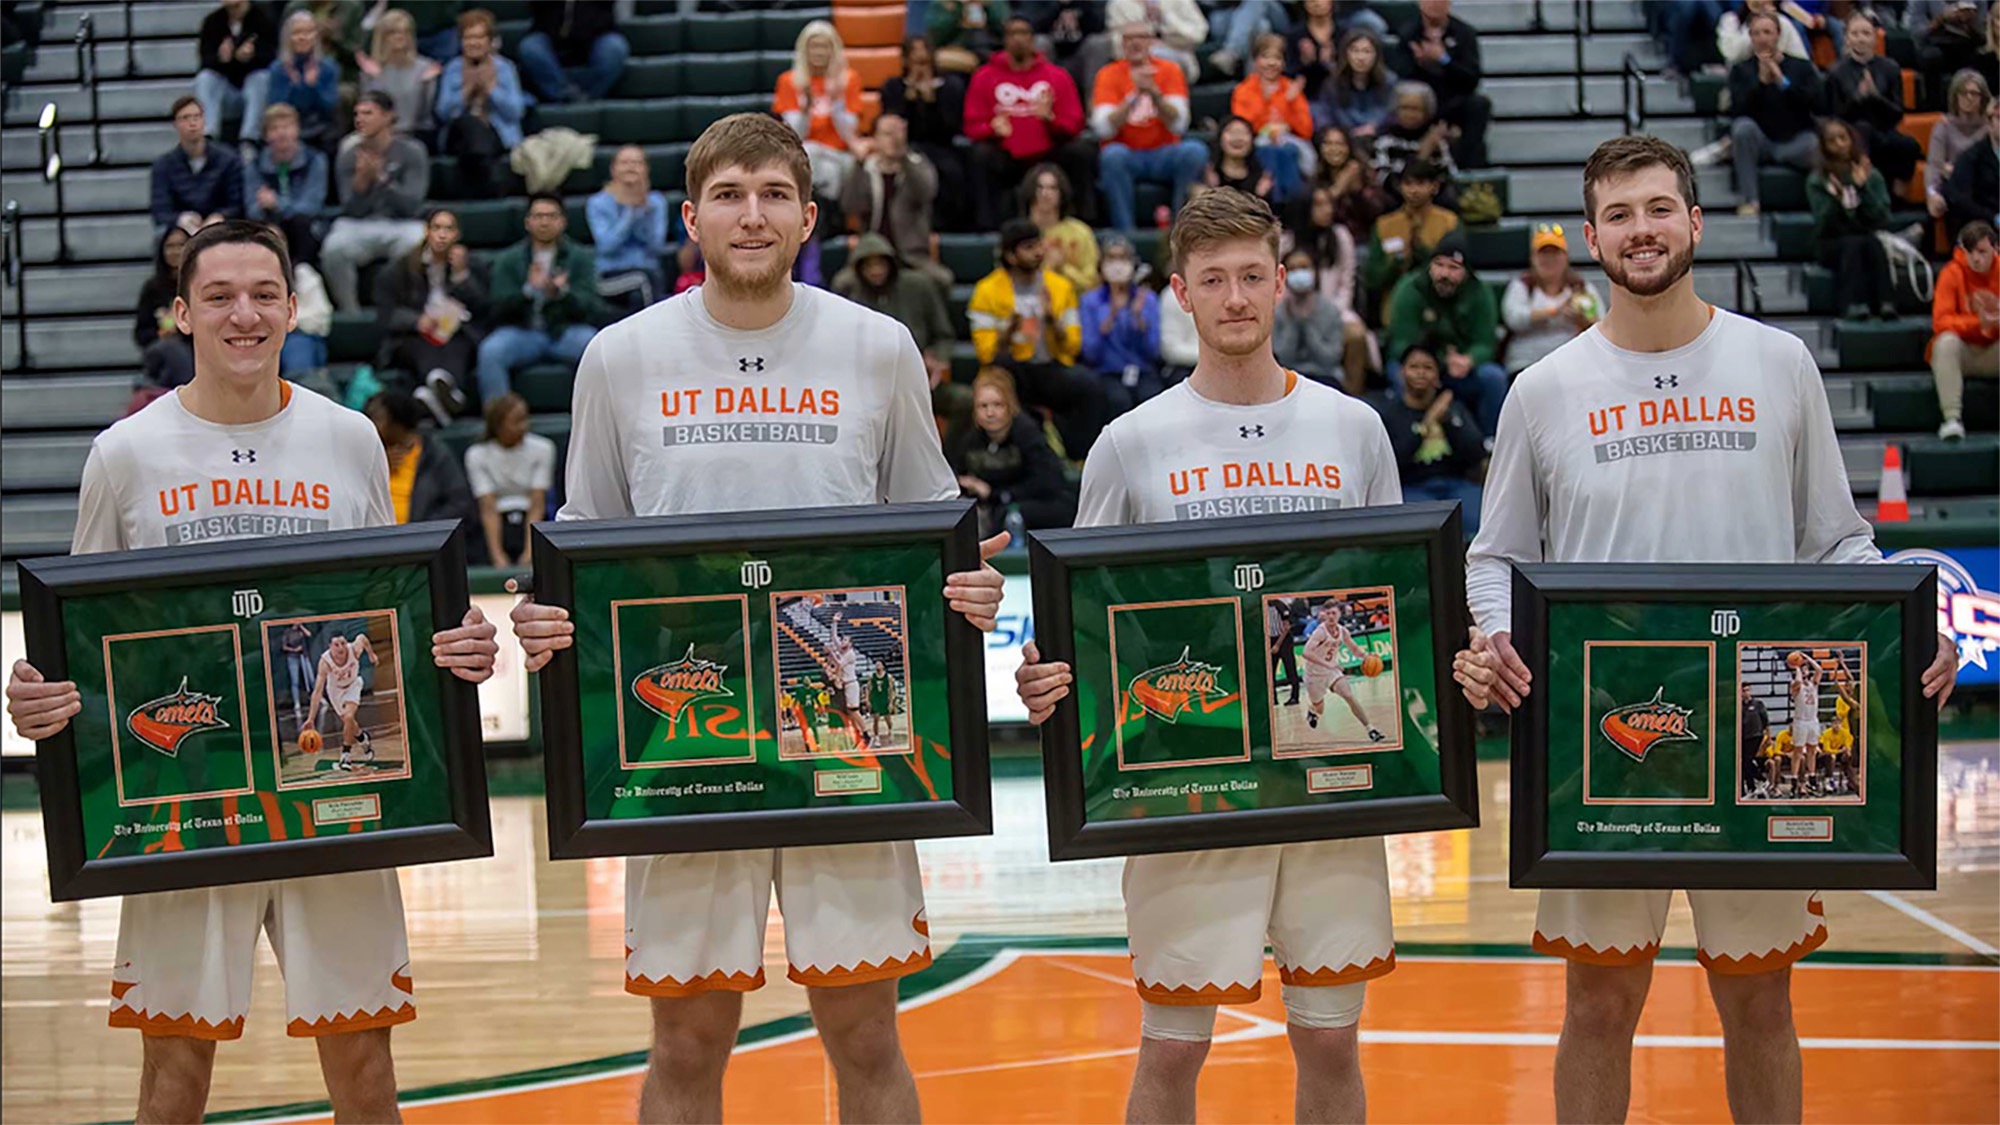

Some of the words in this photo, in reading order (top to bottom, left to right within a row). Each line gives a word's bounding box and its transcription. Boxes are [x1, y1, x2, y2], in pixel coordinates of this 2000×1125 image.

[661, 390, 702, 417] UT
[715, 387, 840, 416] DALLAS
[1588, 404, 1627, 436] UT
[1639, 396, 1756, 427] DALLAS
[675, 424, 826, 444] BASKETBALL
[1606, 432, 1745, 460] BASKETBALL
[1169, 467, 1209, 496] UT
[1222, 461, 1342, 490] DALLAS
[159, 483, 199, 516] UT
[211, 478, 331, 511] DALLAS
[741, 560, 773, 589] UTD
[1234, 563, 1265, 592] UTD
[232, 589, 264, 618] UTD
[1711, 610, 1741, 638] UTD
[614, 787, 632, 798] The
[633, 785, 682, 797] University
[683, 784, 694, 795] of
[694, 783, 723, 794] Texas
[1112, 788, 1130, 799] The
[1132, 785, 1178, 797] University
[1179, 784, 1190, 794] of
[1190, 783, 1218, 794] Texas
[114, 824, 132, 836] The
[133, 821, 181, 834] University
[183, 819, 193, 829] of
[194, 817, 222, 828] Texas
[1576, 821, 1595, 833] The
[1596, 822, 1642, 835] University
[1643, 822, 1653, 832] of
[1654, 822, 1681, 833] Texas
